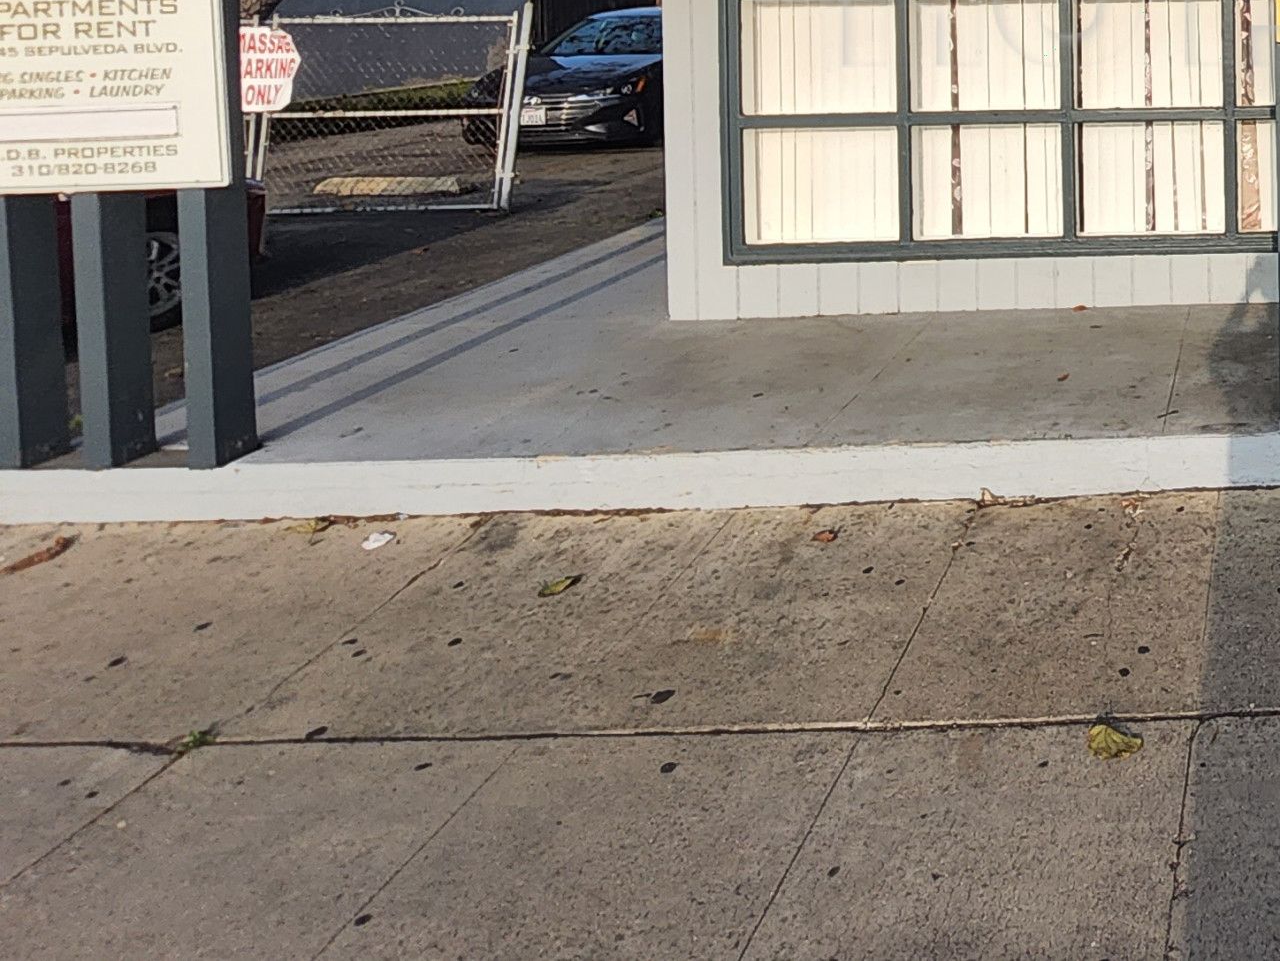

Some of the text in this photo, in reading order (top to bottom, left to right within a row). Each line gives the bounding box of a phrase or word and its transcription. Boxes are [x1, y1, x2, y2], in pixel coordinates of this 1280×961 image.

[0, 20, 156, 40] FOR RENT
[24, 44, 128, 57] SEPULVEDA
[133, 42, 183, 55] BLVD.
[19, 70, 85, 84] SINGLES
[103, 67, 173, 81] KITCHEN
[243, 57, 296, 79] ARKING
[0, 84, 165, 100] PARKING LAUNDRY
[245, 84, 283, 105] ONLY
[54, 144, 178, 159] PROPERTIES
